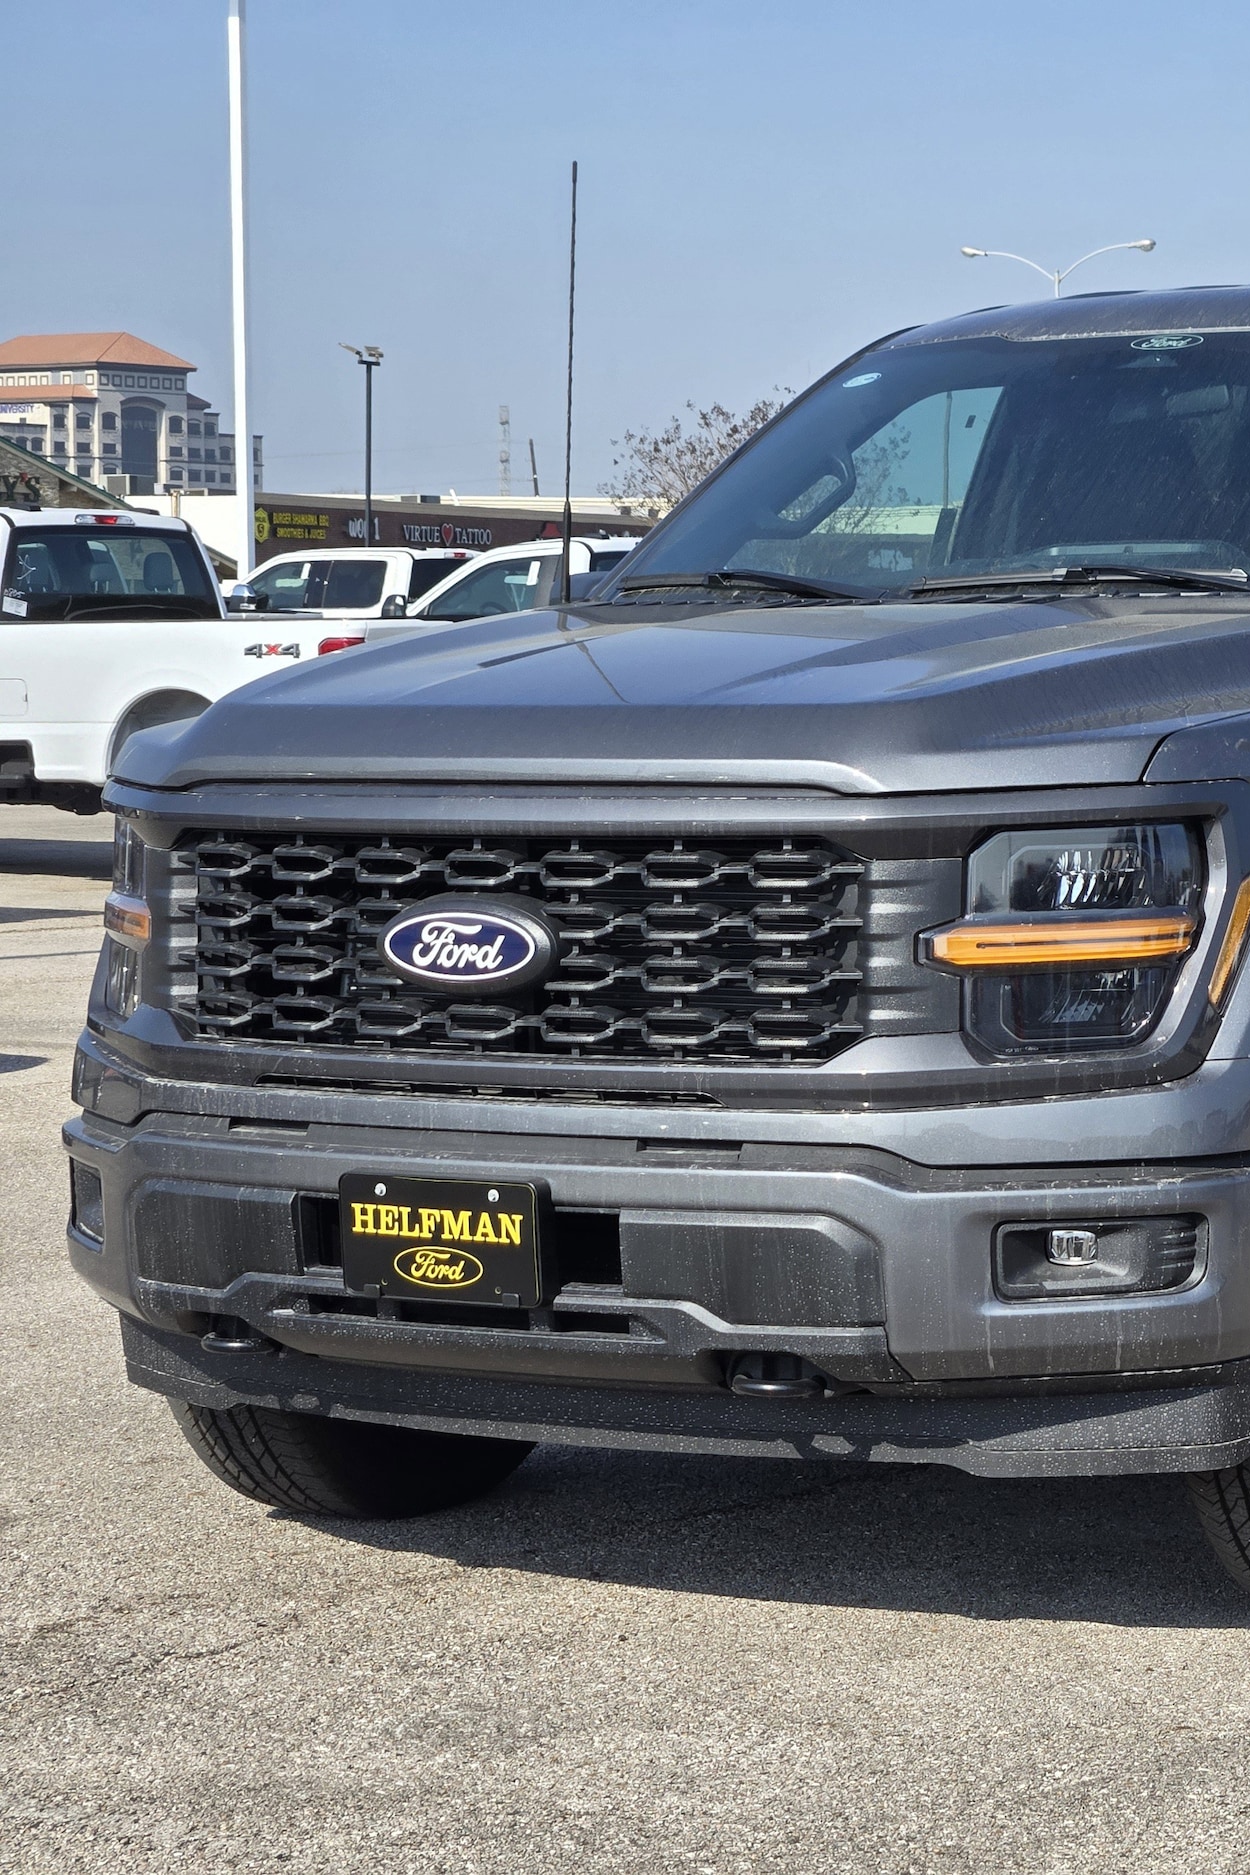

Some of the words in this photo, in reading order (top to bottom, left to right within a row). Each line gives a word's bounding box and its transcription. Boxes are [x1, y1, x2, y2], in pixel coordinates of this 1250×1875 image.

[1141, 336, 1193, 348] Ford
[402, 524, 441, 543] VIRTUE
[454, 527, 493, 545] TATTOO
[412, 921, 505, 970] Ford
[350, 1202, 524, 1246] HELFMAN
[410, 1250, 466, 1281] Ford
